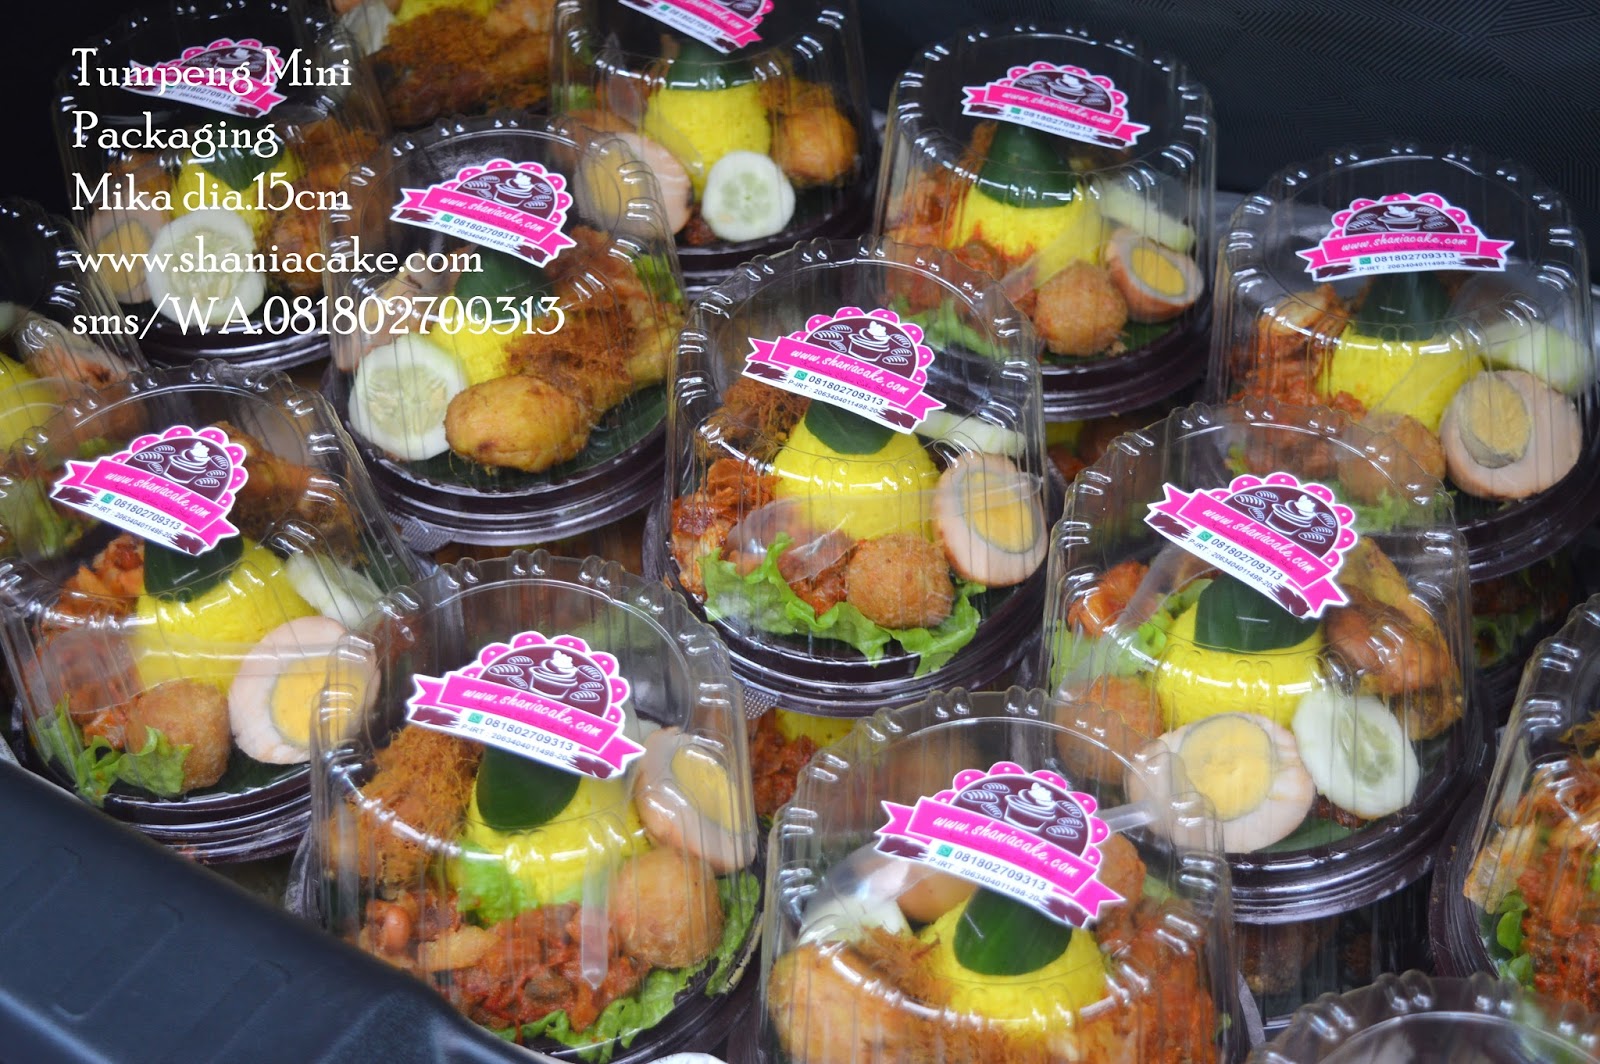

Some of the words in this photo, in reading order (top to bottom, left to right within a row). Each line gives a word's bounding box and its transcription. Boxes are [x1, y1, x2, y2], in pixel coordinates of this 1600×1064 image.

[439, 195, 545, 233] www.shaniacake.com
[453, 218, 521, 243] 081802709313
[1341, 232, 1468, 251] www.shaniacake.com
[1374, 252, 1455, 263] 081802709313
[790, 349, 910, 395] www.shaniacake.com
[808, 375, 884, 406] 081802709313
[813, 388, 879, 414] 2063404011498-20
[104, 471, 212, 519] www.shaniacake.com
[113, 498, 182, 531] 081802709313
[1202, 506, 1316, 574] www.shaniacake.com
[1210, 537, 1283, 580] 081802709313
[1211, 551, 1273, 588] 2063404011498-20
[462, 687, 604, 738] www.shaniacake.com
[484, 717, 574, 751] 081802709313
[932, 813, 1079, 878] www.shaniacake.com
[954, 849, 1047, 891] 081802709313
